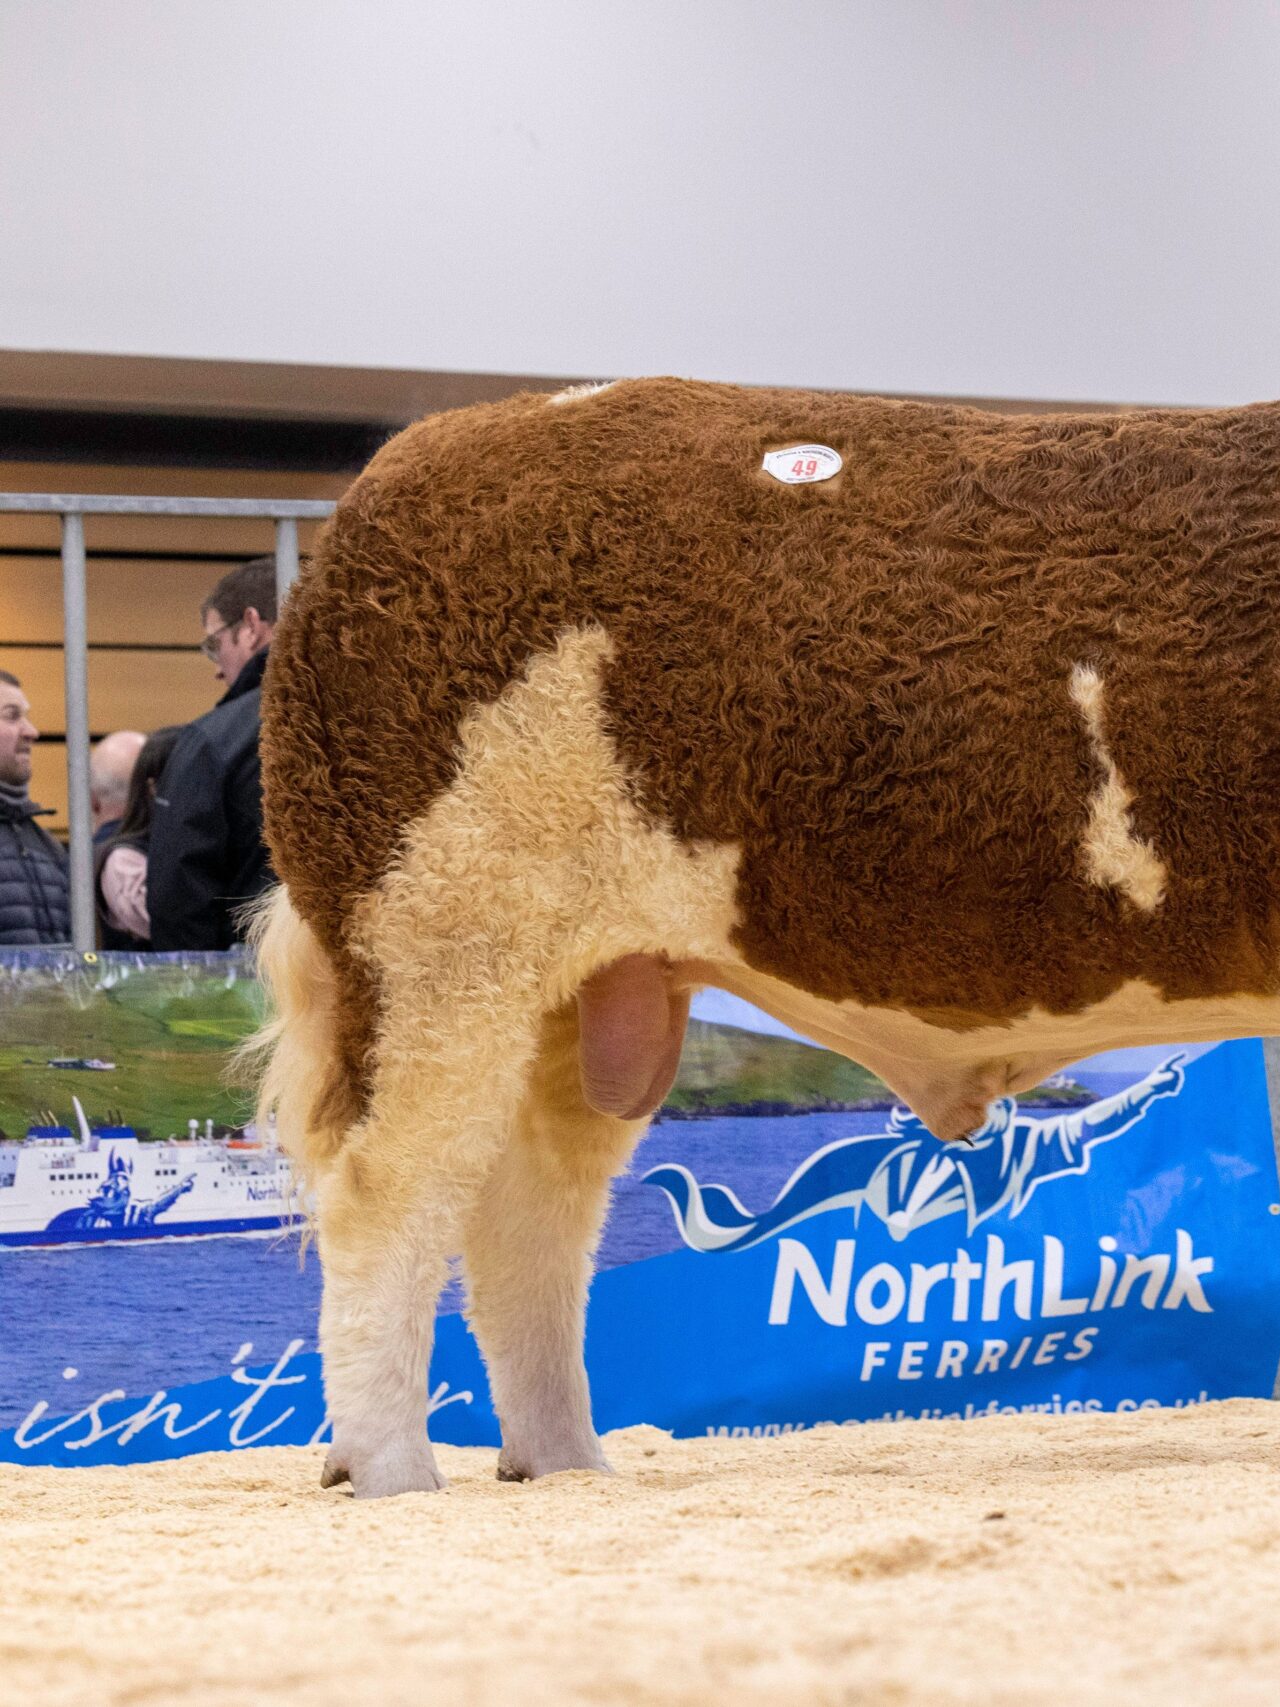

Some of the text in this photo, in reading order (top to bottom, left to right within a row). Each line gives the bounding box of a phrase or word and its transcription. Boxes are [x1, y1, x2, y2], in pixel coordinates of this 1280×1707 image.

[791, 460, 818, 477] 49
[767, 1227, 1214, 1327] NorthLink
[859, 1326, 1101, 1382] FERRIES
[14, 1338, 307, 1449] isn't
